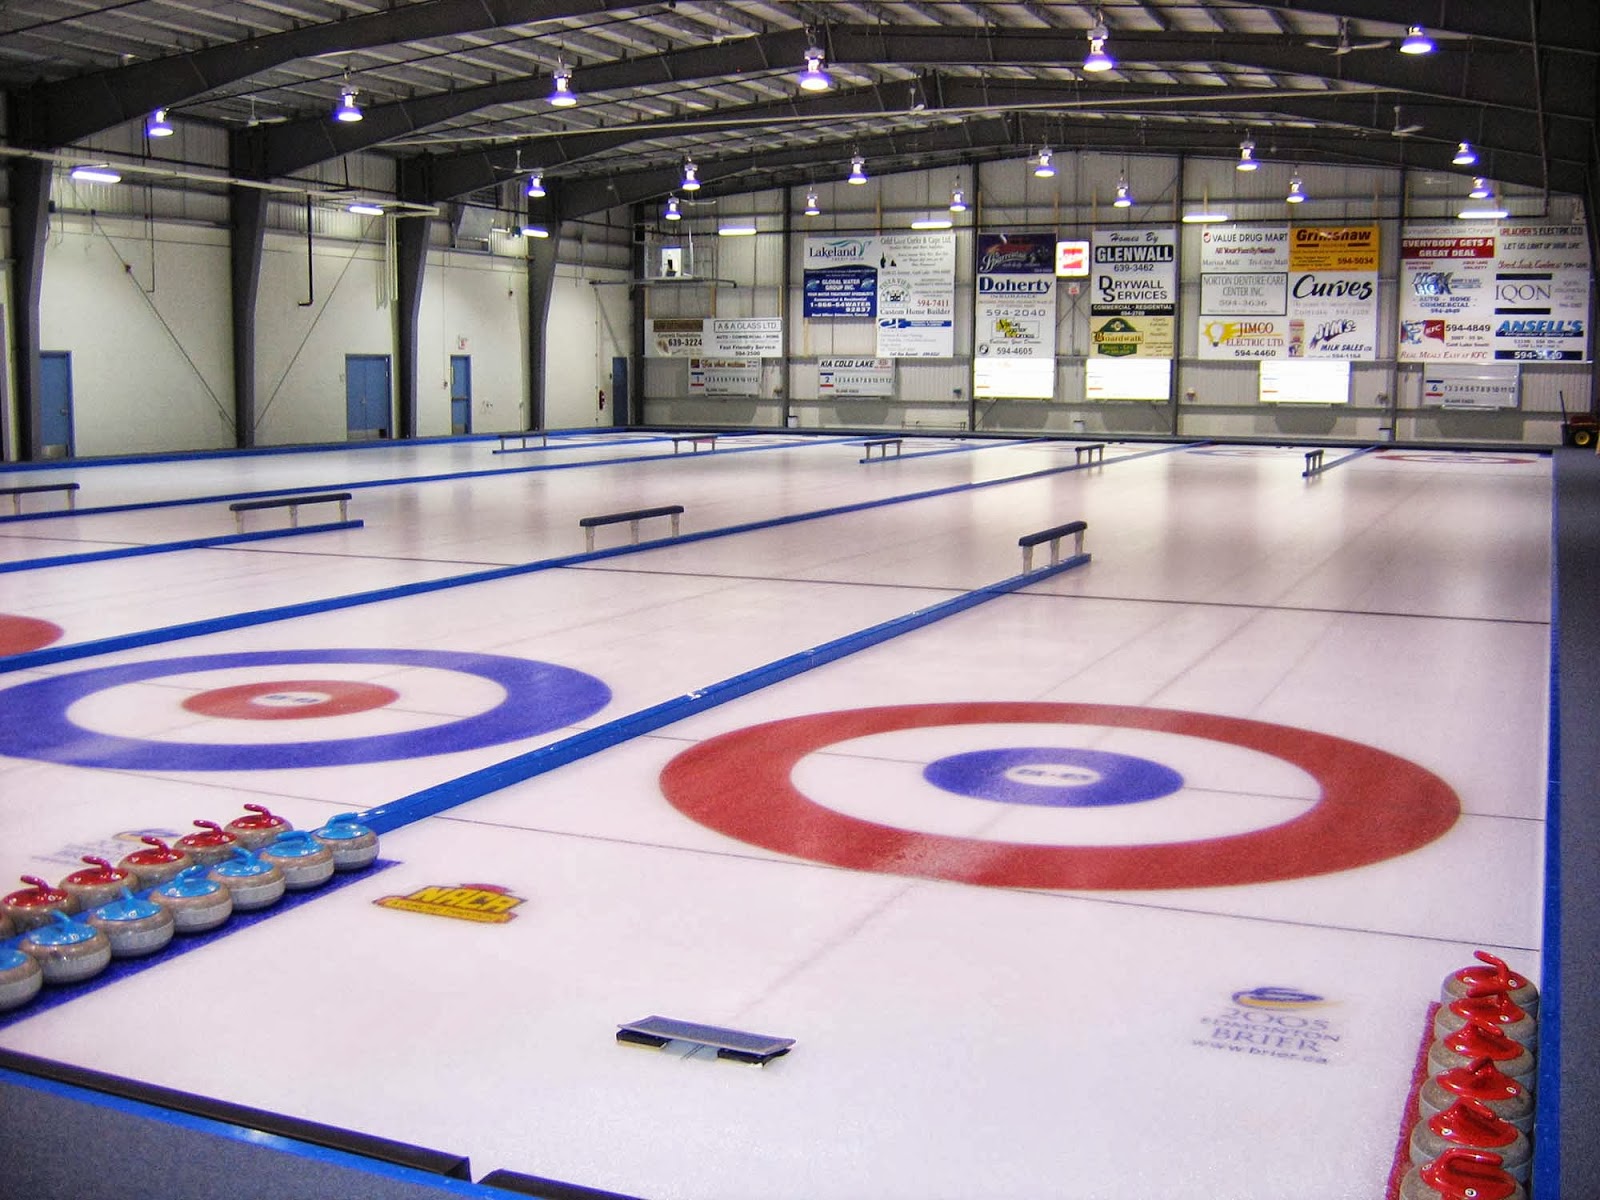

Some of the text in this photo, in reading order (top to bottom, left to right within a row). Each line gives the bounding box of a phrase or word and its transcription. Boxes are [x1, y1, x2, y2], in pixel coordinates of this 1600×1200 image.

[1110, 231, 1158, 243] Homes By
[1212, 233, 1288, 242] VALUE DRUG MART
[1460, 239, 1484, 247] GETS
[810, 246, 856, 258] Lakeland
[1096, 246, 1172, 262] GLENWALL
[1114, 264, 1154, 272] 639-3462
[980, 277, 1053, 292] Doherty
[1099, 276, 1164, 290] DRYWALL
[1293, 274, 1373, 300] Curves
[1102, 289, 1168, 302] SERVICES
[1496, 284, 1552, 304] IQON
[986, 309, 1046, 317] 594-2040
[737, 322, 762, 330] GLASS
[1239, 322, 1274, 337] JIMCO
[1425, 324, 1441, 334] KFC
[1446, 324, 1491, 332] 594-4849
[1498, 320, 1583, 332] ANSELL'S
[668, 339, 703, 347] 639-3224
[1226, 338, 1266, 347] ELECTRIC
[834, 360, 854, 368] COLD
[855, 360, 875, 368] LAKE
[1432, 384, 1438, 392] 6
[1212, 1027, 1321, 1053] BRIER
